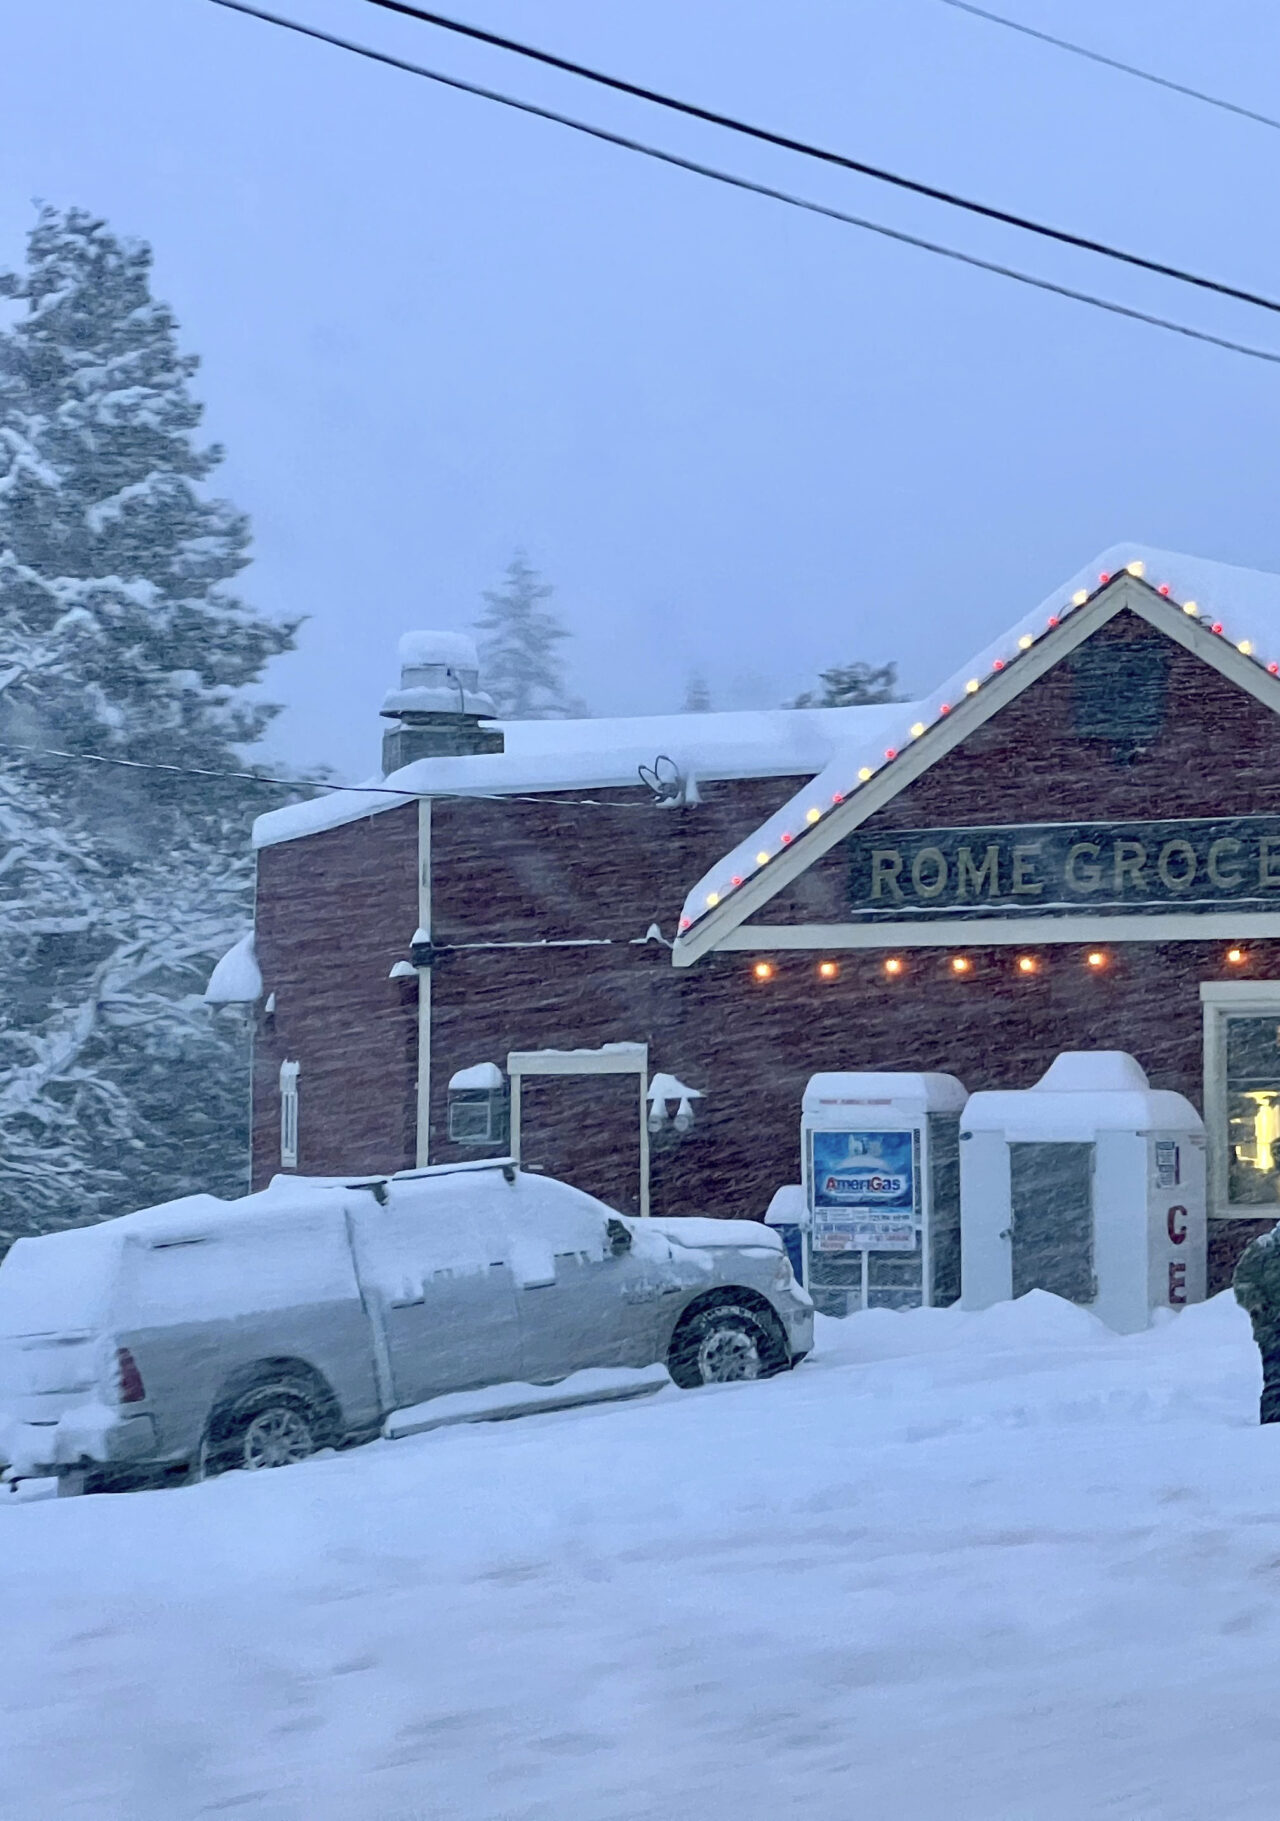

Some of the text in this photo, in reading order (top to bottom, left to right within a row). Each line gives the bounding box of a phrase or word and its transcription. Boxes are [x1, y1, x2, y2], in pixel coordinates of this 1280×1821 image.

[869, 844, 1043, 899] ROME
[826, 1176, 901, 1191] AmeriGas
[1167, 1146, 1188, 1304] ICE
